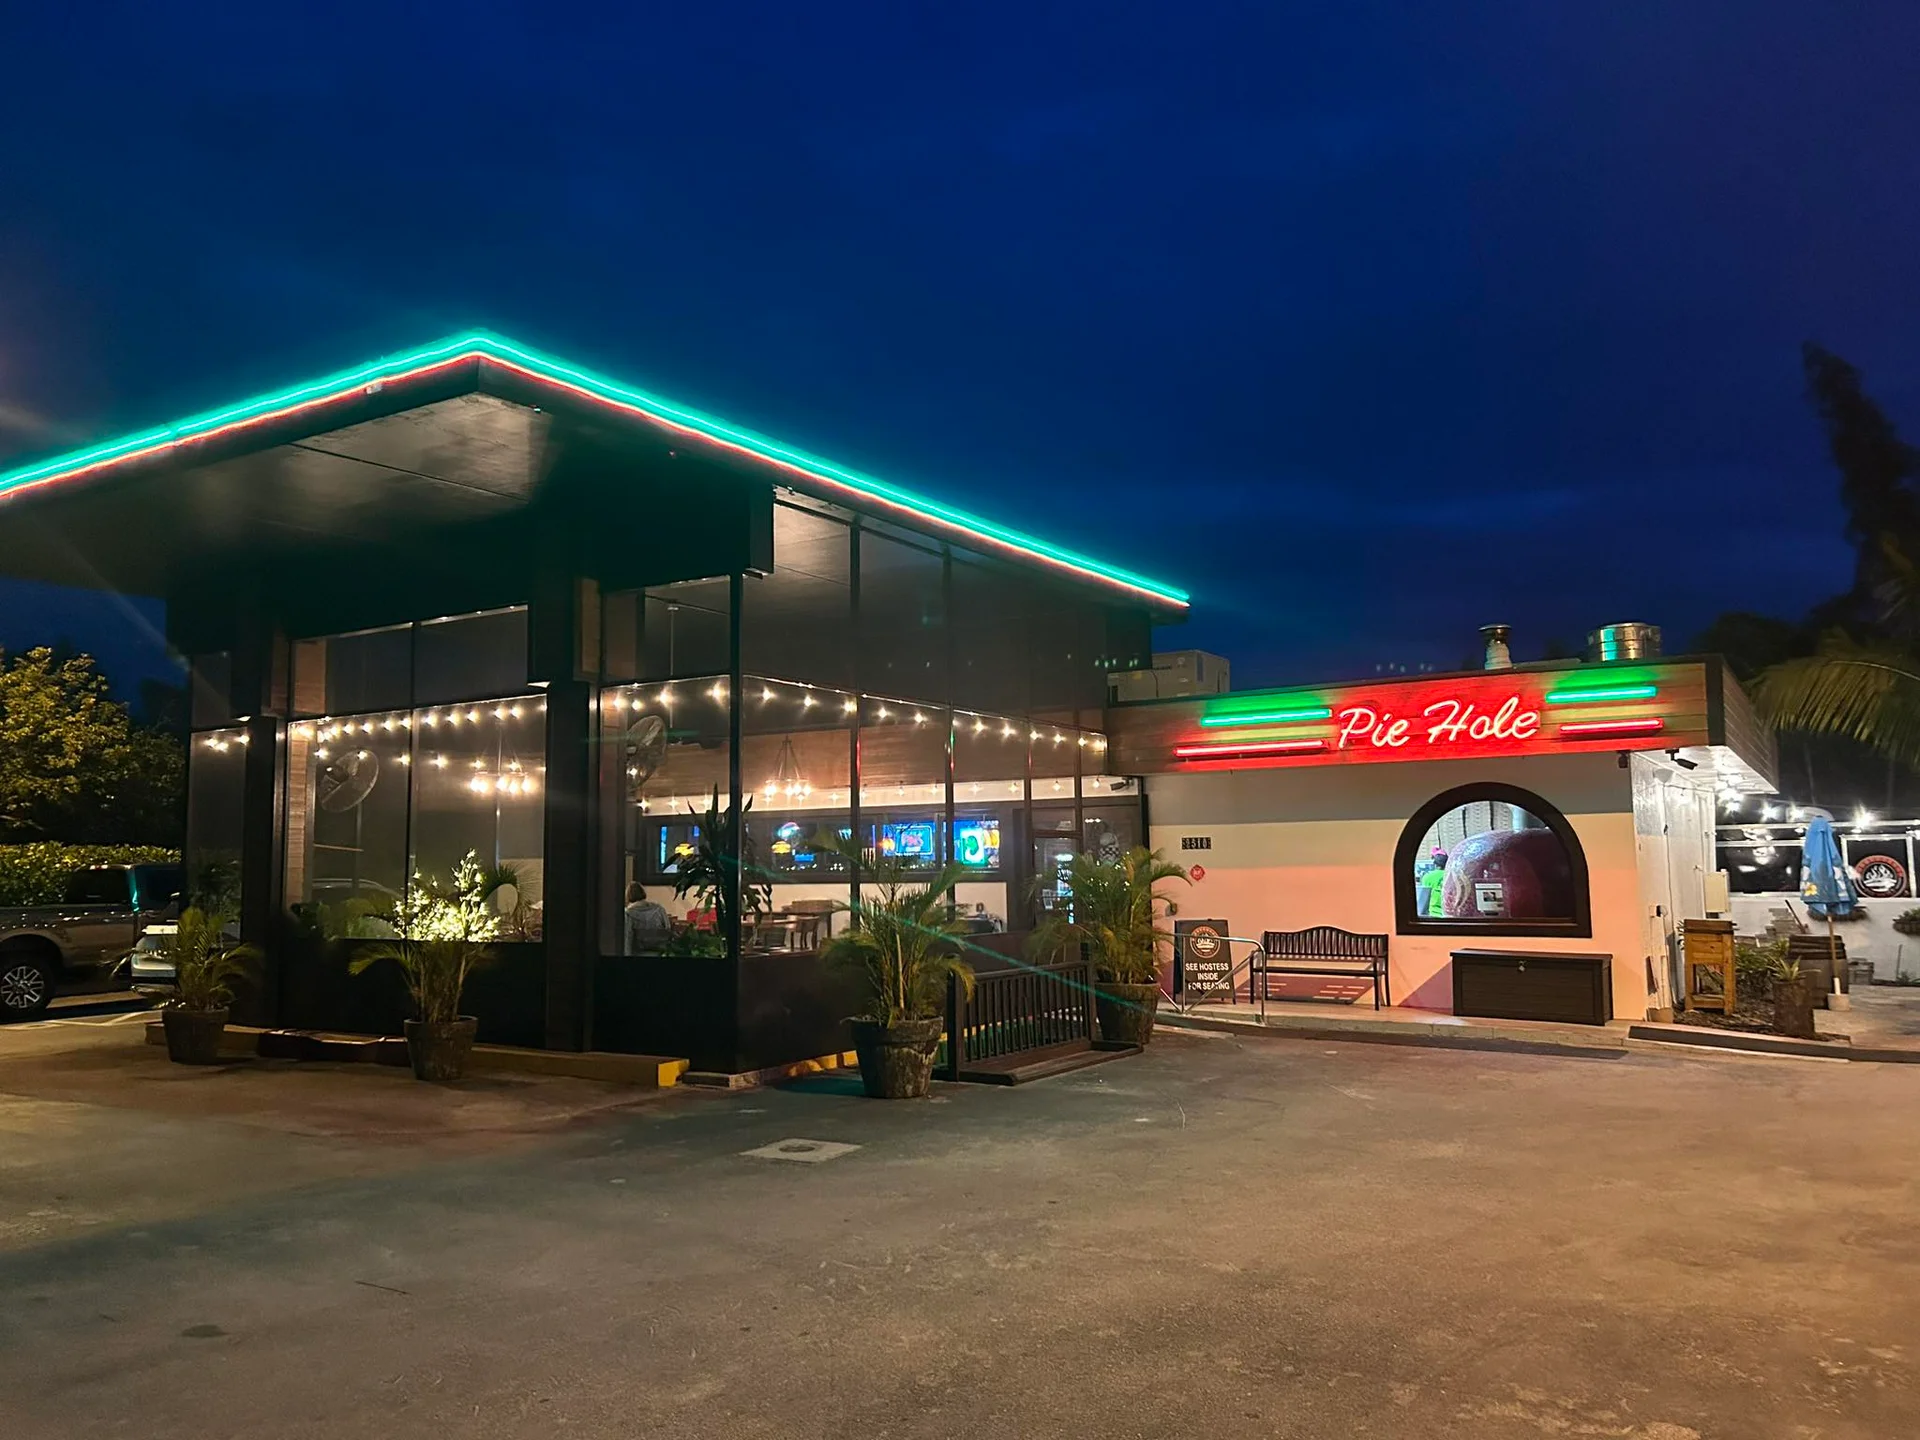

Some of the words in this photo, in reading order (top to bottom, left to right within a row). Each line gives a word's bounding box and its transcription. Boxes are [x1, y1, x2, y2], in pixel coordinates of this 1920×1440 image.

[1338, 707, 1411, 749] Pie
[1423, 695, 1538, 744] Hole
[1185, 962, 1198, 971] SEE
[1199, 962, 1229, 971] HOSTESS
[1197, 972, 1219, 981] INSIDE
[1187, 982, 1201, 991] FOR
